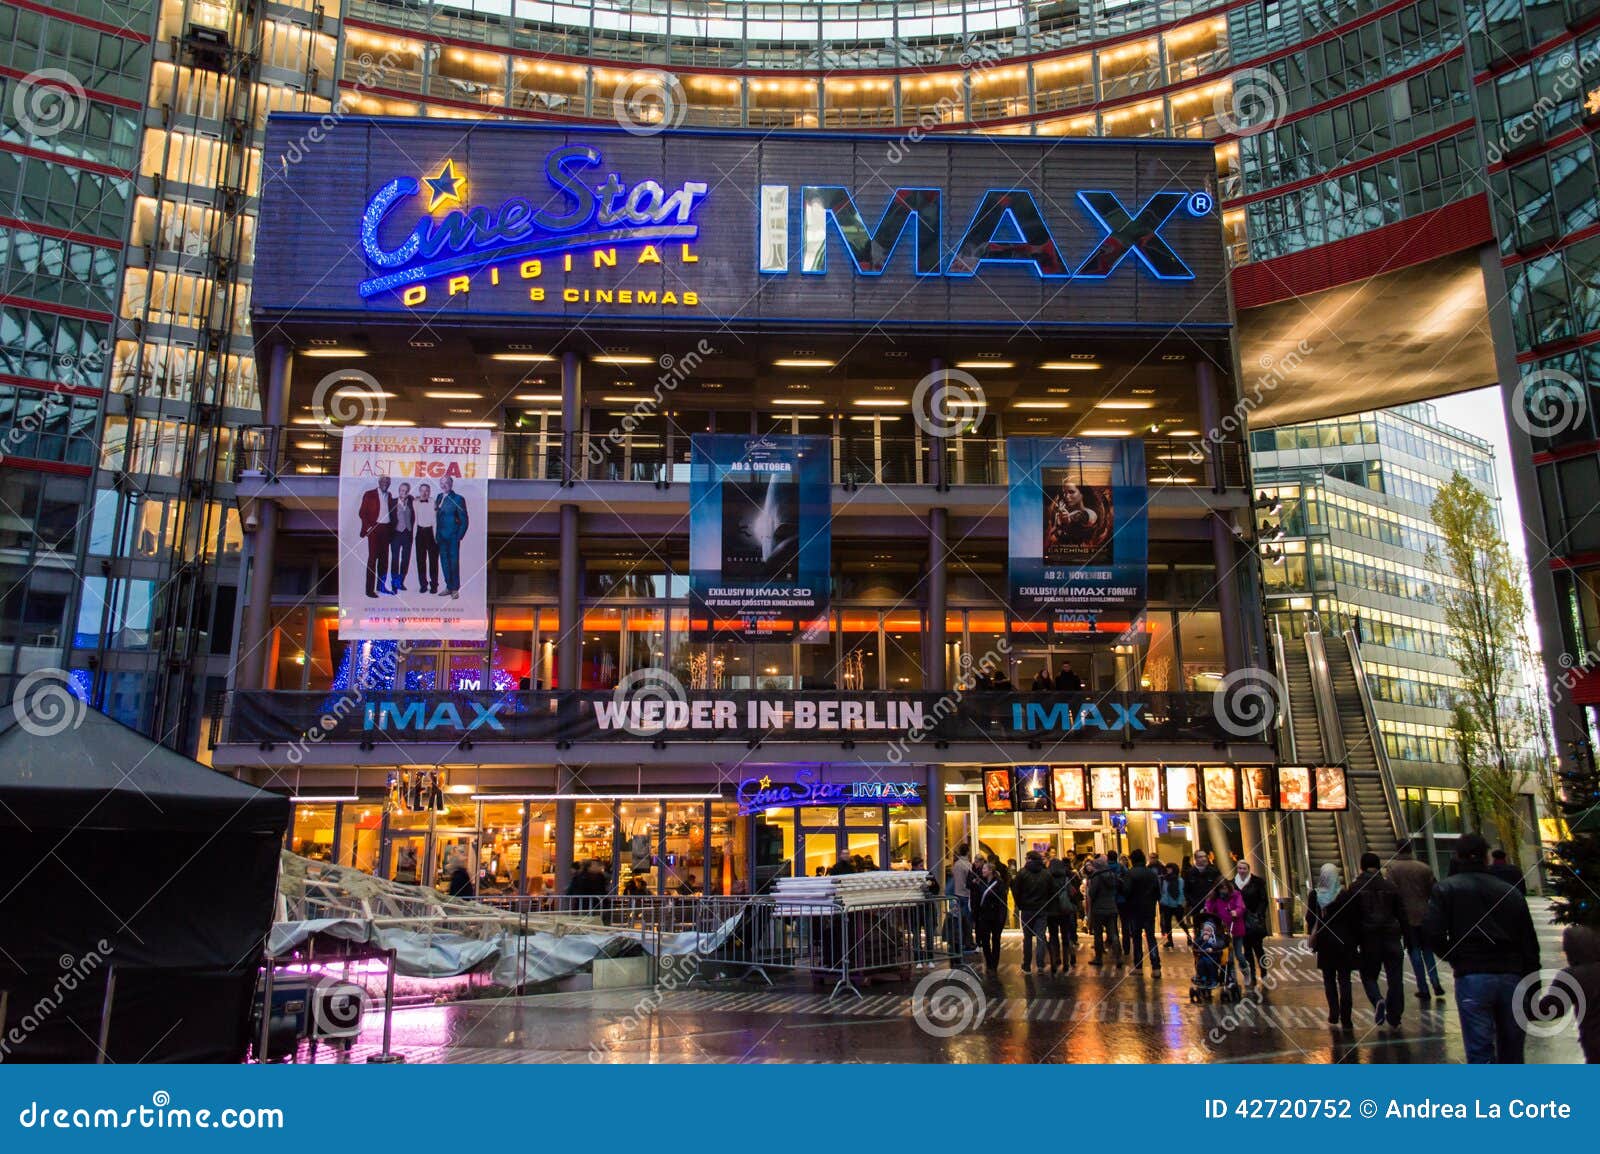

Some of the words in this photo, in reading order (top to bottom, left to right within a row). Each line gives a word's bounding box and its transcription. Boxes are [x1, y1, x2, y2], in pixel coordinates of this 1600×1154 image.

[404, 244, 699, 307] ORIGINAL
[530, 288, 545, 301] 8
[563, 288, 699, 305] CINEMAS
[353, 435, 419, 444] DOUGLAS
[423, 437, 443, 446] DE
[446, 437, 482, 446] NIRO
[352, 443, 429, 453] FREEMAN
[432, 445, 481, 455] KLINE
[352, 460, 396, 477] LAST
[398, 461, 476, 478] VEGAS
[731, 462, 743, 471] AB
[753, 462, 792, 472] OKTOBER
[1044, 571, 1056, 580] AB
[1069, 571, 1113, 580] NOVEMBER
[708, 588, 745, 596] EXKLUSIV
[746, 588, 755, 596] IN
[756, 588, 790, 597] IMAX
[792, 588, 812, 597] 3D
[1019, 587, 1058, 596] EXKLUSIV
[1058, 587, 1069, 596] IM
[1070, 587, 1105, 596] IMAX
[1107, 587, 1137, 596] FORMAT
[1059, 613, 1097, 623] IMAX
[459, 678, 504, 691] IMX
[363, 702, 505, 731] IMAX
[593, 700, 738, 730] WIEDER
[747, 700, 784, 730] IN
[793, 700, 924, 730] BERLIN
[1011, 702, 1148, 731] IMAX
[852, 782, 920, 798] IMAX
